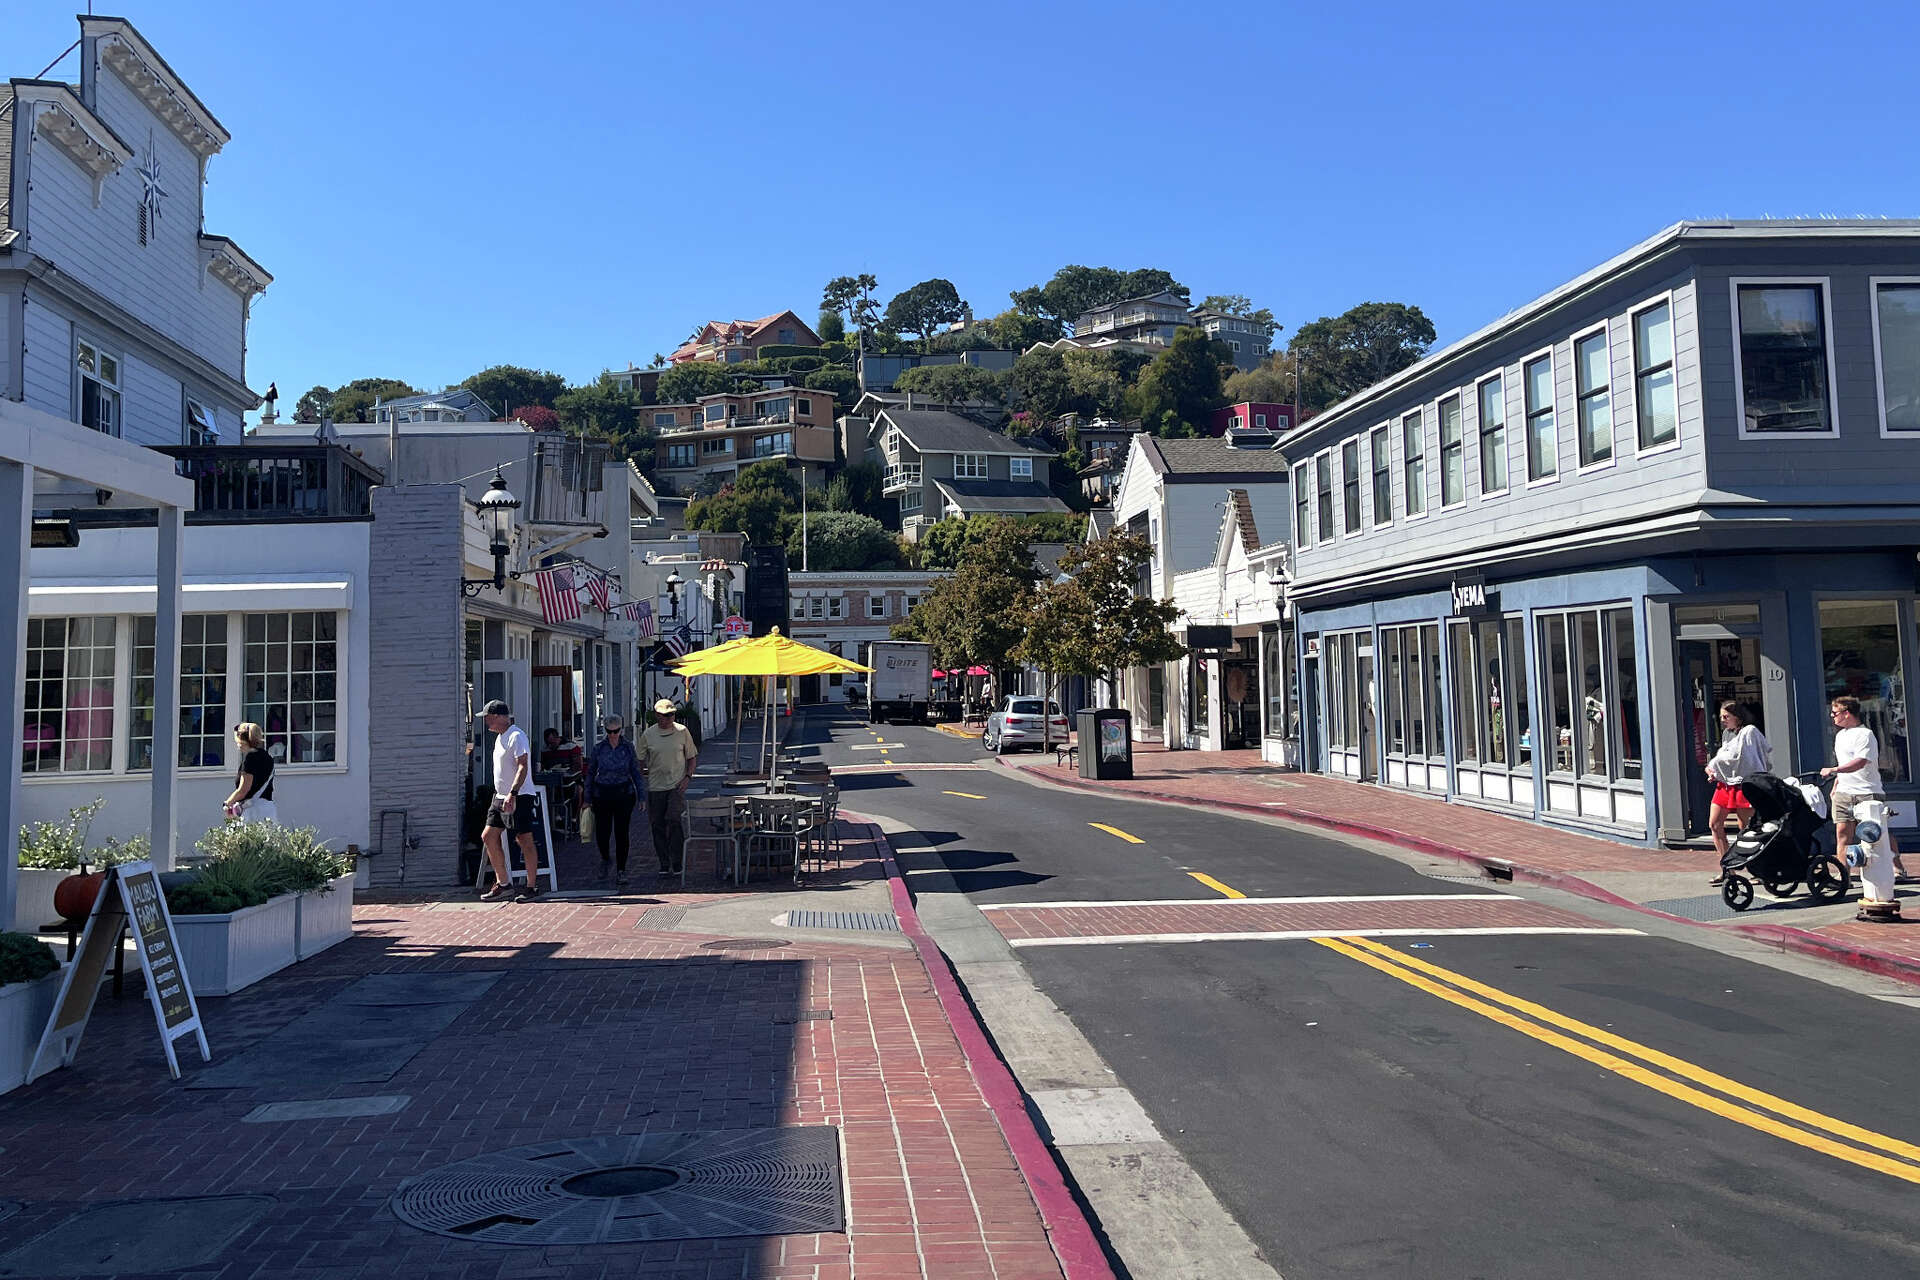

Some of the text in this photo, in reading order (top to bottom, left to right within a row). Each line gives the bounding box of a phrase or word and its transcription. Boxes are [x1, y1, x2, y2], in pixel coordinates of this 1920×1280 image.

[1457, 584, 1486, 608] YEMA
[1769, 669, 1784, 682] 10
[136, 904, 160, 927] FARM
